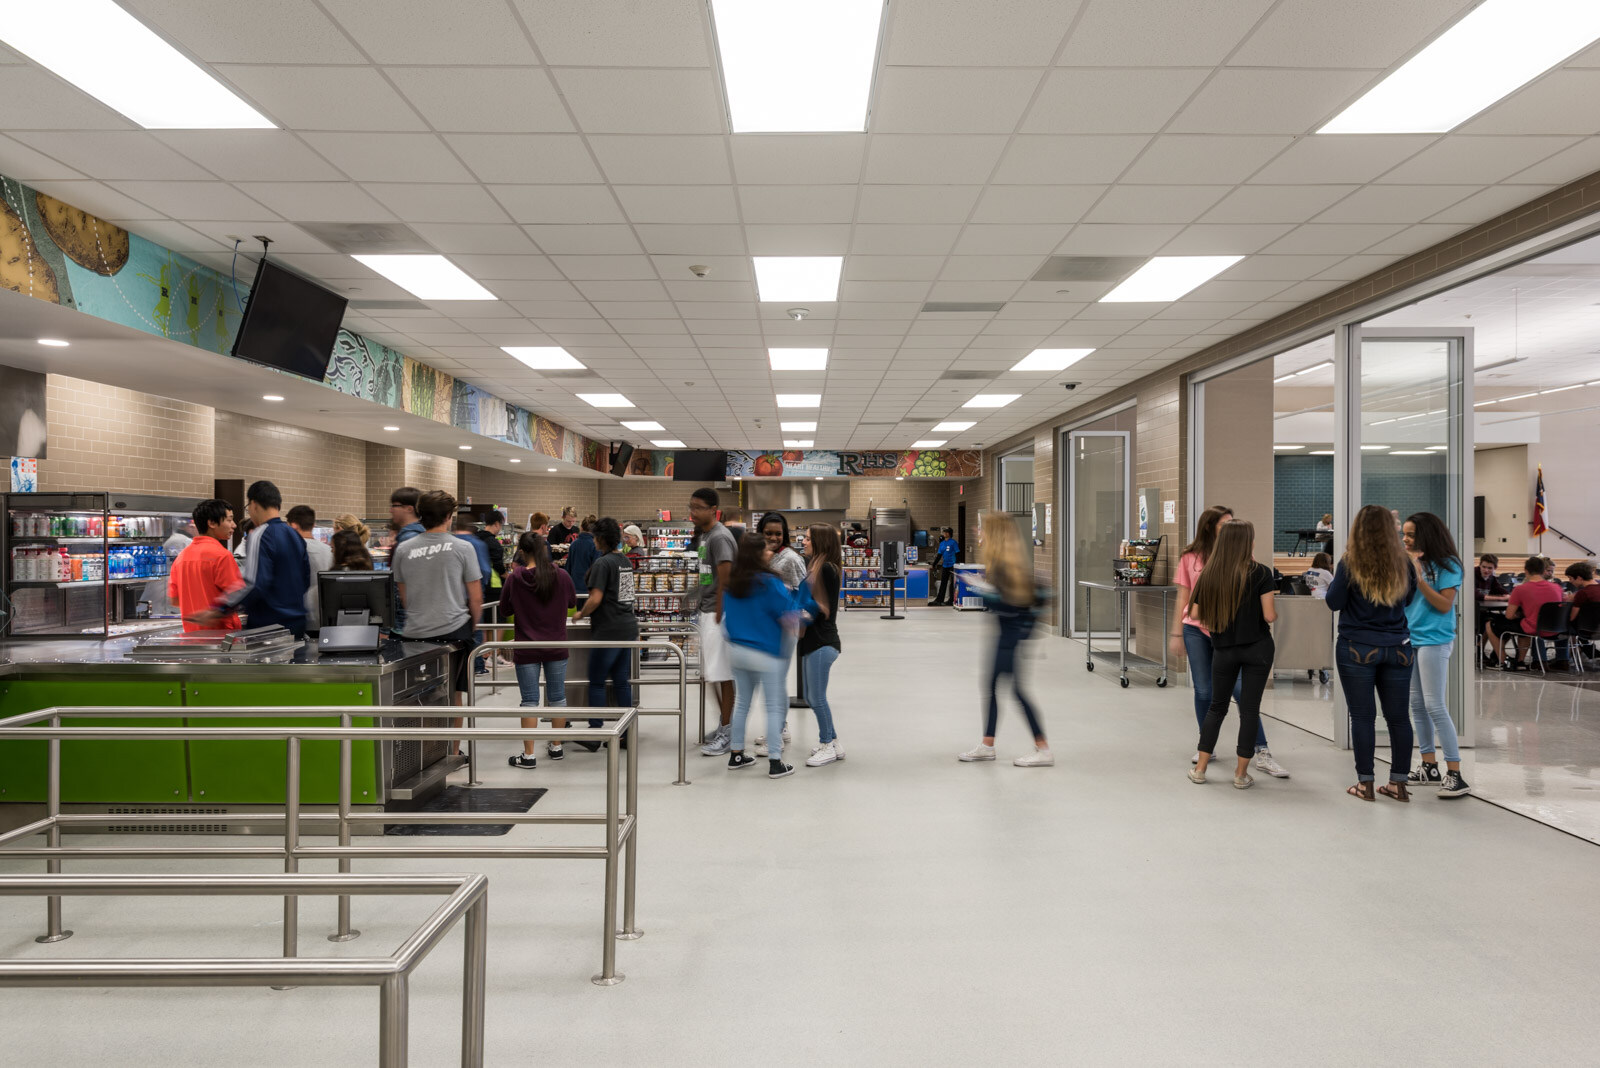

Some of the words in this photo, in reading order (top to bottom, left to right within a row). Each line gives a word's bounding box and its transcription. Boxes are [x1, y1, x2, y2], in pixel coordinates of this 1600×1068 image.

[837, 452, 898, 475] RHS
[408, 546, 428, 559] JUST
[428, 543, 442, 555] DO
[442, 542, 453, 551] IT.
